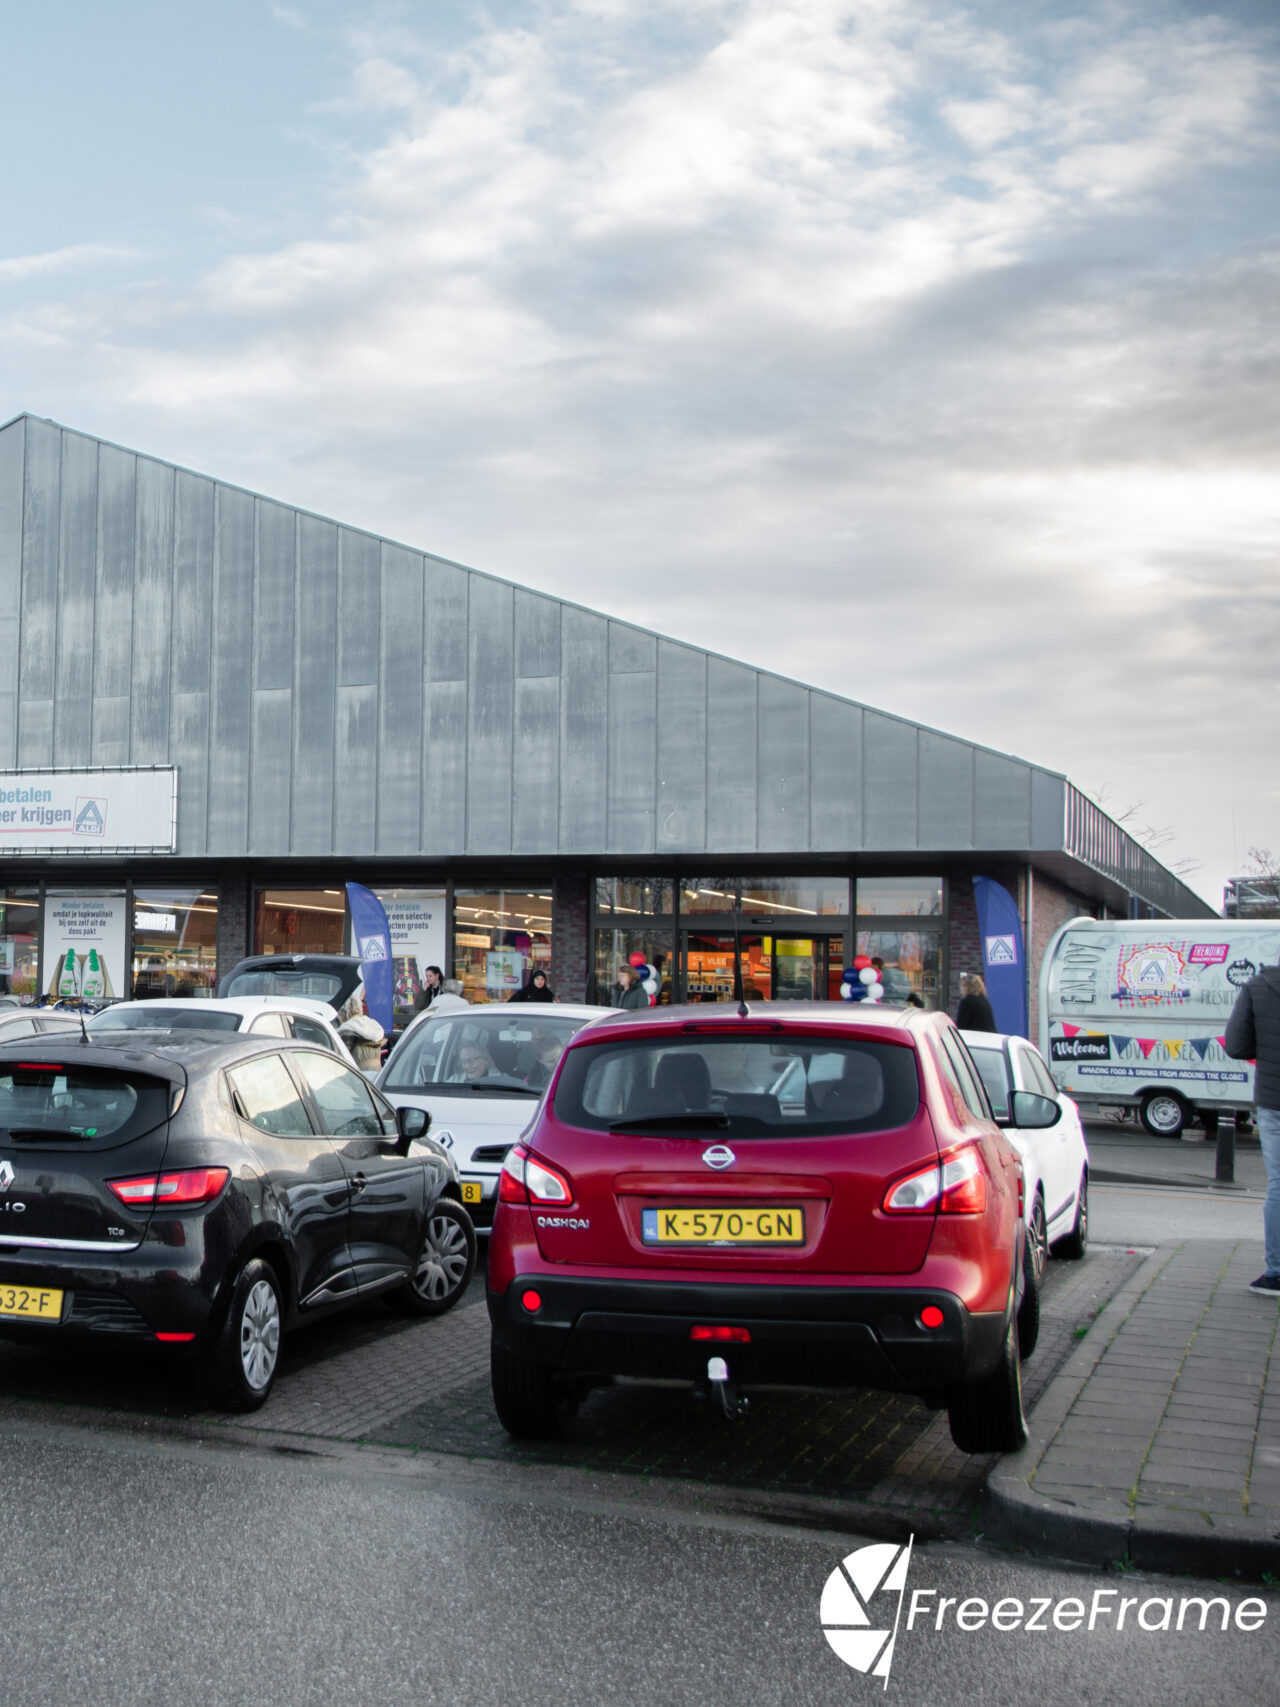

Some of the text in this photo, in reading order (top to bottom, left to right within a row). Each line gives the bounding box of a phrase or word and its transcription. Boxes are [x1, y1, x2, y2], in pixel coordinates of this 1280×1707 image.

[22, 806, 71, 825] krijgen
[78, 825, 100, 833] ALDI
[78, 911, 113, 919] topkwaliteit
[406, 912, 432, 920] selectie
[407, 922, 429, 931] groots
[83, 928, 96, 936] pakt
[1193, 946, 1225, 956] TRENDING
[1059, 942, 1106, 1006] ENJOY
[1052, 1039, 1108, 1057] Welcome
[1081, 1067, 1109, 1075] AMAZING
[1135, 1069, 1158, 1077] DRINKS
[1179, 1071, 1205, 1079] AROUND
[1220, 1073, 1244, 1081] GLOBE!
[537, 1216, 590, 1229] QASHQAI
[664, 1213, 793, 1236] K-570-GN
[107, 1227, 125, 1236] TCe
[645, 1228, 656, 1236] NL
